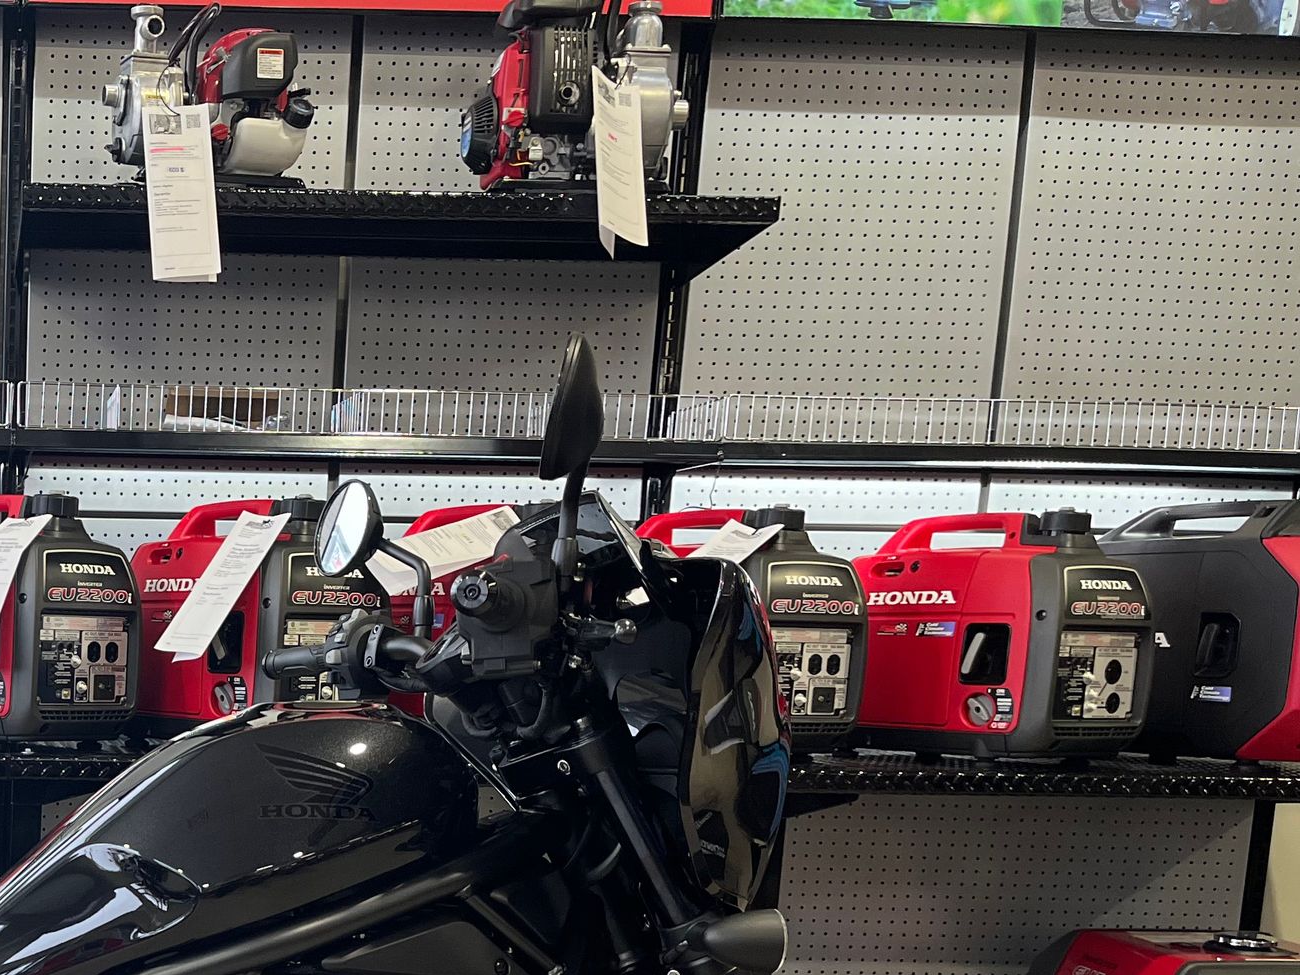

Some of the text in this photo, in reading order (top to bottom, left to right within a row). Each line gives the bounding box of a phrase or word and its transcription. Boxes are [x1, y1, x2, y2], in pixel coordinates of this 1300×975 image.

[60, 563, 115, 575] HONDA
[144, 578, 200, 592] HOND
[784, 575, 843, 586] HONDA
[1080, 580, 1132, 590] HONDA
[47, 586, 132, 604] EU2200i
[292, 590, 381, 607] EU2200i
[866, 590, 956, 605] HONDA
[771, 599, 859, 615] EU2200i
[1070, 601, 1145, 616] EU2200i
[260, 804, 376, 820] HONDA
